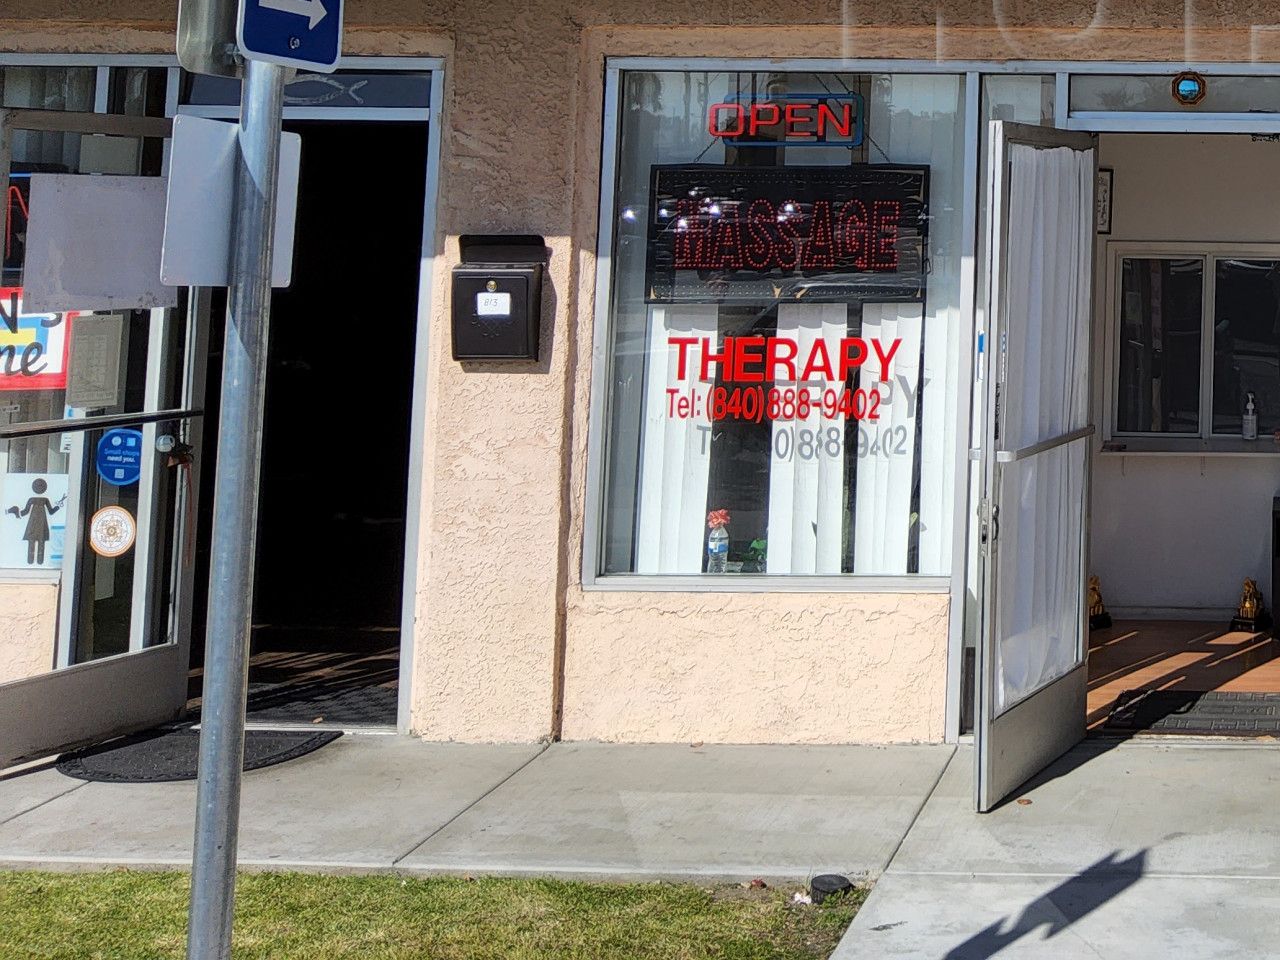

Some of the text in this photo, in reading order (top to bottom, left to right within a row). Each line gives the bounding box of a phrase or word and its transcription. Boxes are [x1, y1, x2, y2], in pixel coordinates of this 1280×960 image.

[708, 102, 851, 137] OPEN
[673, 198, 901, 269] MASSAGE
[667, 336, 903, 382] THERAPY
[665, 386, 881, 423] Tel: (840)888-9402
